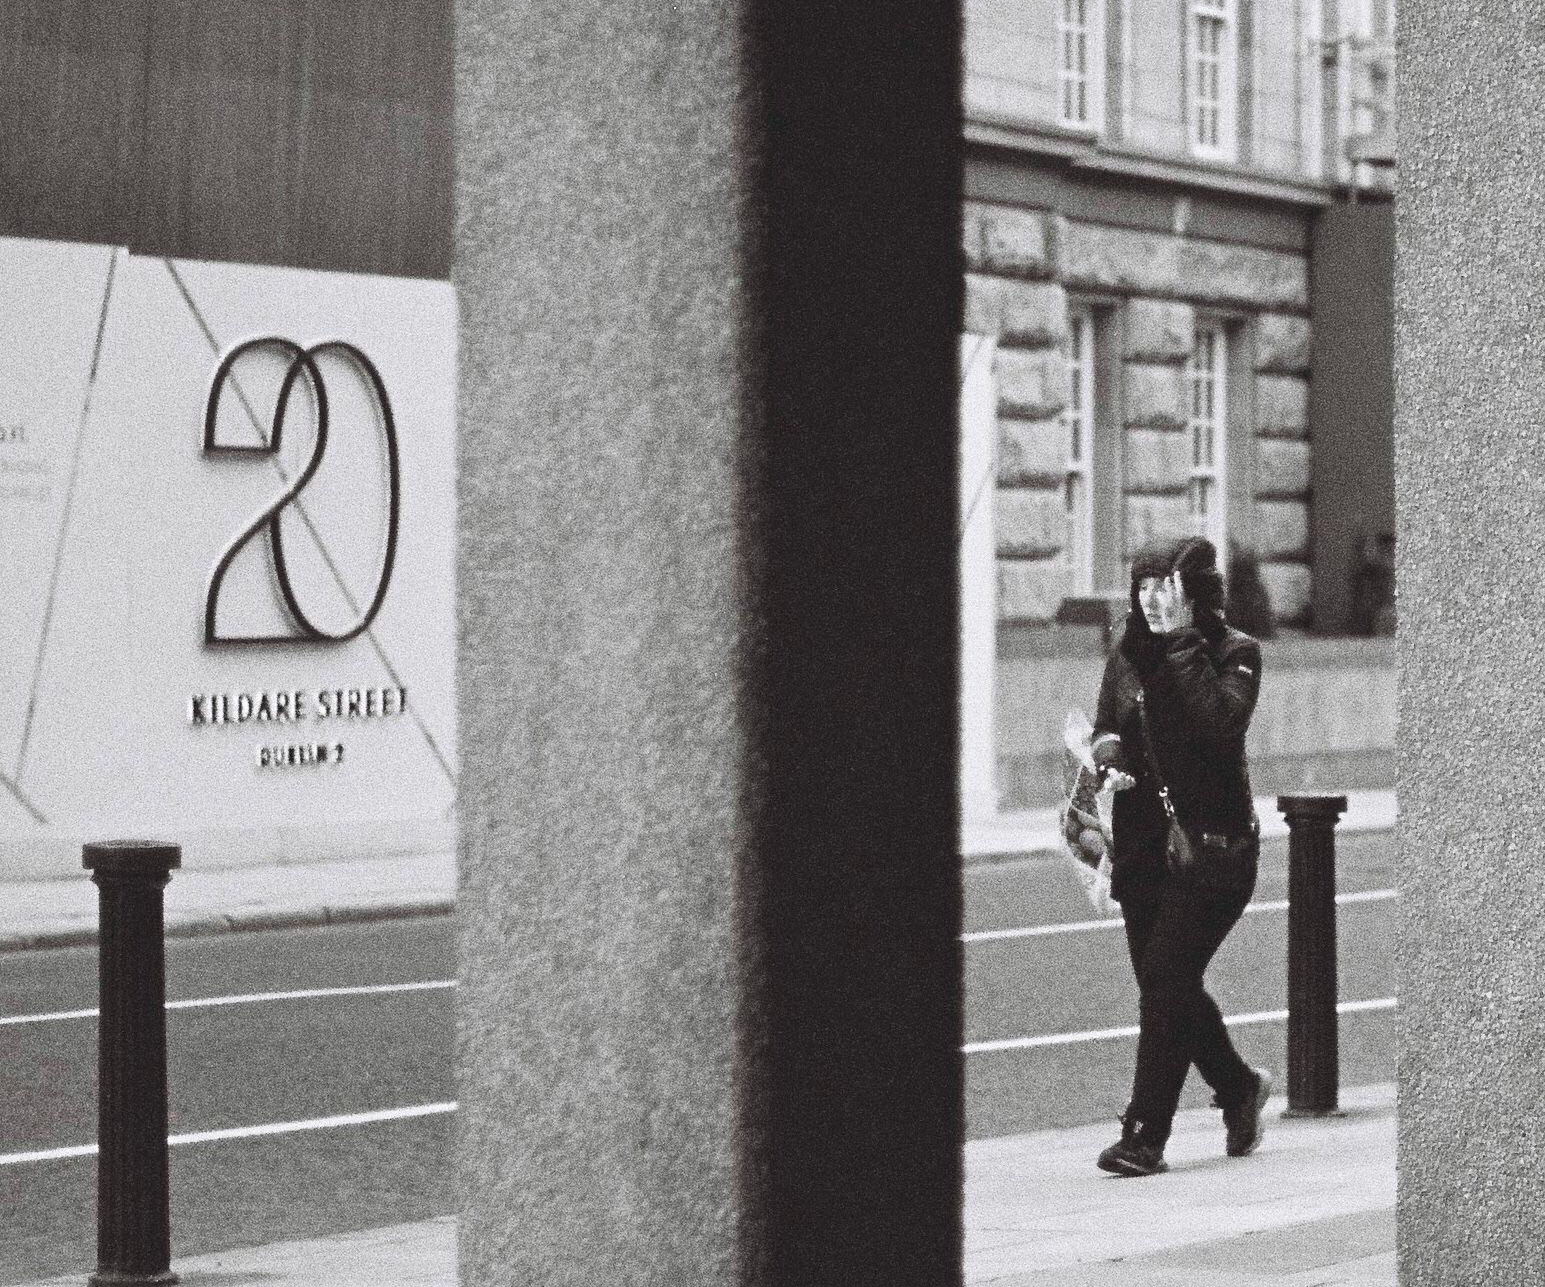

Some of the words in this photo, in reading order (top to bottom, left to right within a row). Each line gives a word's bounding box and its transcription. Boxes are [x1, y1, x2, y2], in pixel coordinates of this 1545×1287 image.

[203, 337, 400, 648] 20
[191, 691, 306, 725] KILDARE
[317, 687, 408, 721] STREET
